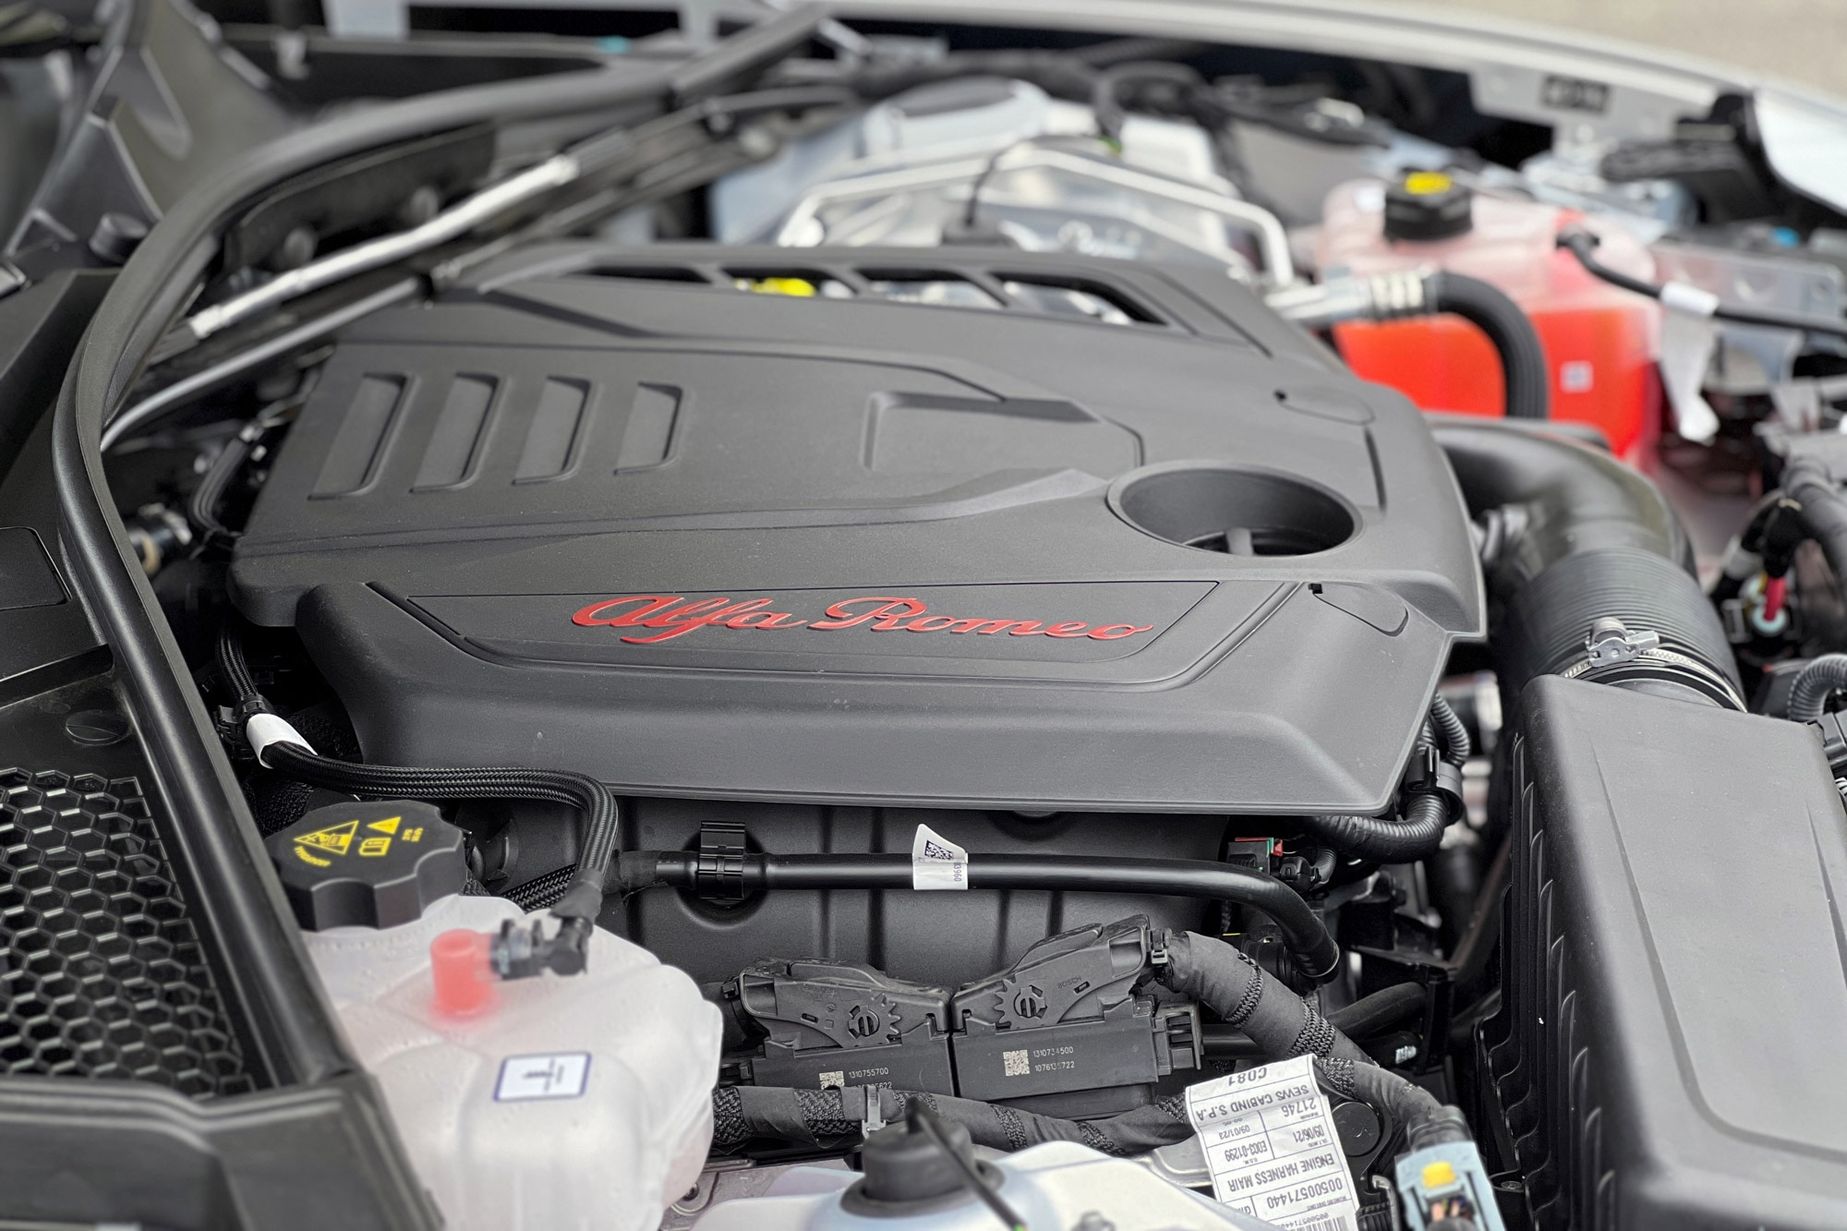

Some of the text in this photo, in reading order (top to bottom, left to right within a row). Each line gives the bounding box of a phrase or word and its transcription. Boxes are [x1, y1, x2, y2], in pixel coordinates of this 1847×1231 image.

[570, 595, 1153, 644] Alfa Romeo
[848, 1067, 889, 1079] 1310755700
[1228, 1067, 1267, 1086] C081
[1195, 1084, 1309, 1121] SEWS CABIND S.P.A
[1281, 1097, 1317, 1117] 21746
[1254, 1162, 1299, 1185] HARNESS
[1299, 1152, 1335, 1173] ENGINE
[1266, 1177, 1343, 1209] 00500571440
